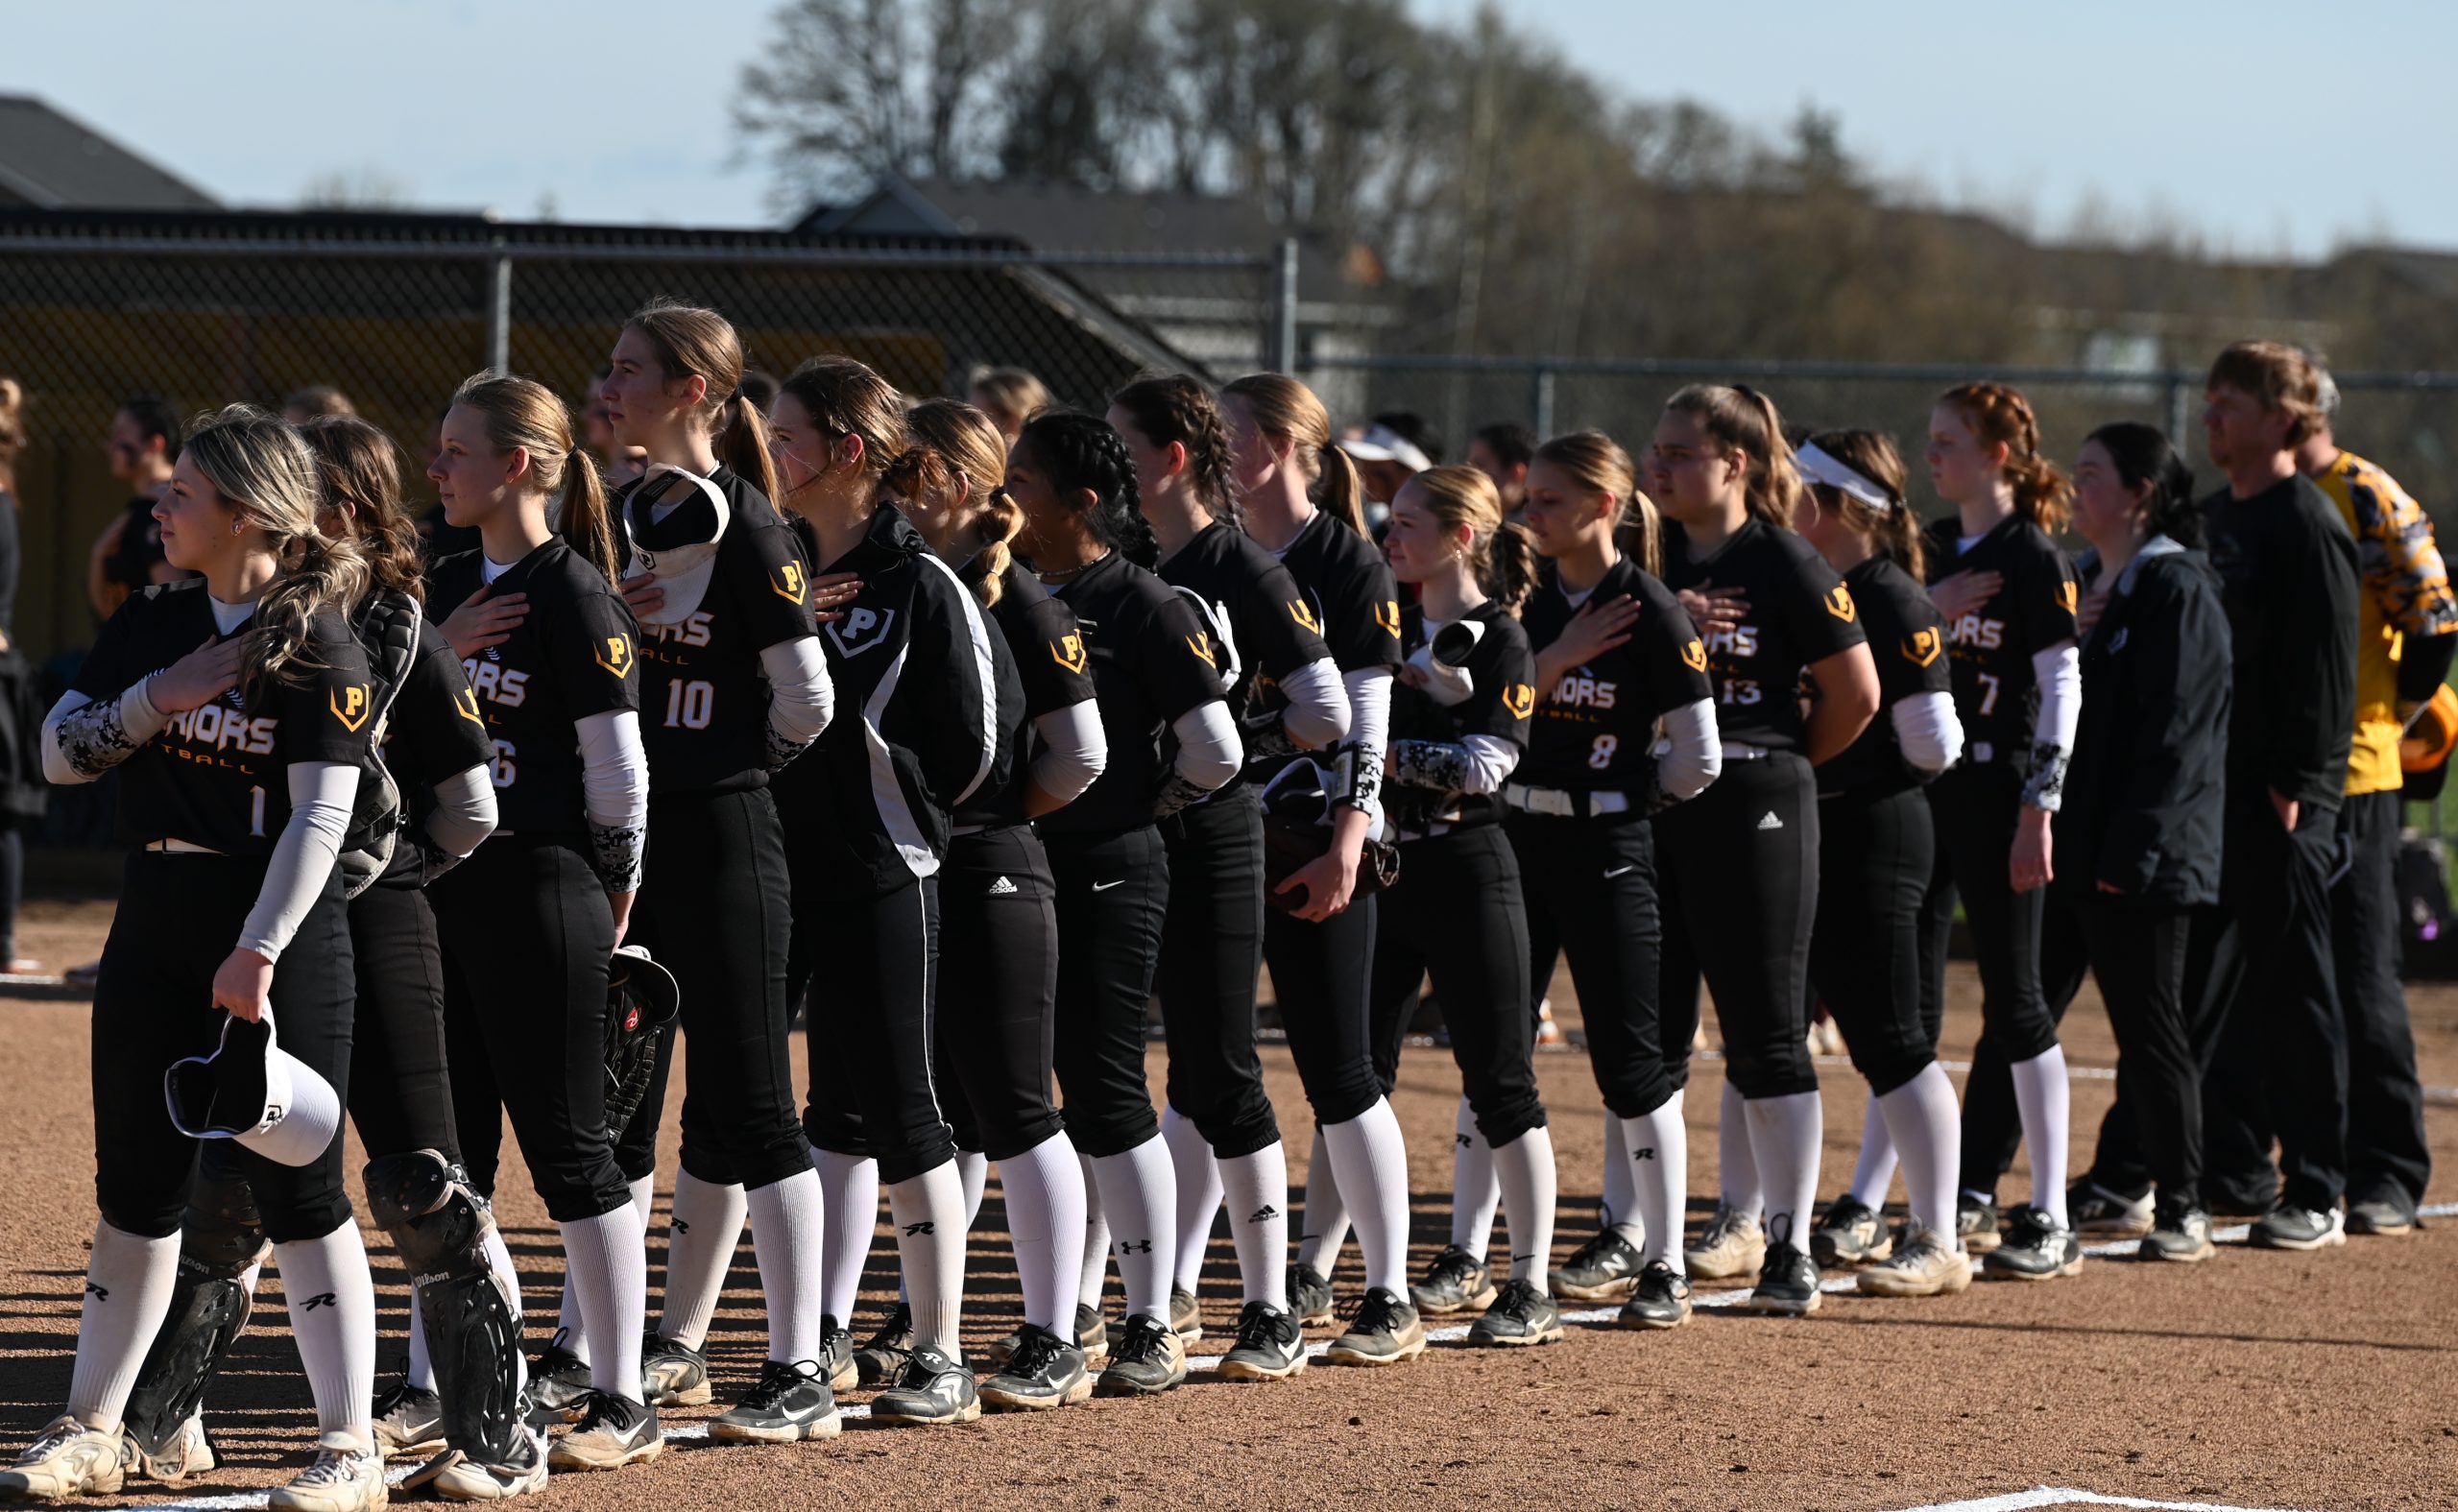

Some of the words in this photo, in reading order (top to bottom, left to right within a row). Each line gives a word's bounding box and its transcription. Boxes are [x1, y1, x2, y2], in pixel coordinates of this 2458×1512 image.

[782, 565, 798, 592] P
[842, 607, 878, 639] P
[608, 637, 625, 663] P
[1061, 636, 1079, 661] P
[346, 686, 363, 716] P
[662, 678, 714, 731] 10
[1722, 679, 1762, 706] 13
[1978, 672, 2000, 715] 7
[160, 743, 254, 775] TBALL
[489, 738, 517, 788] 6
[1588, 733, 1618, 770] 8
[250, 785, 267, 838] 1
[414, 1270, 450, 1288] Wilson
